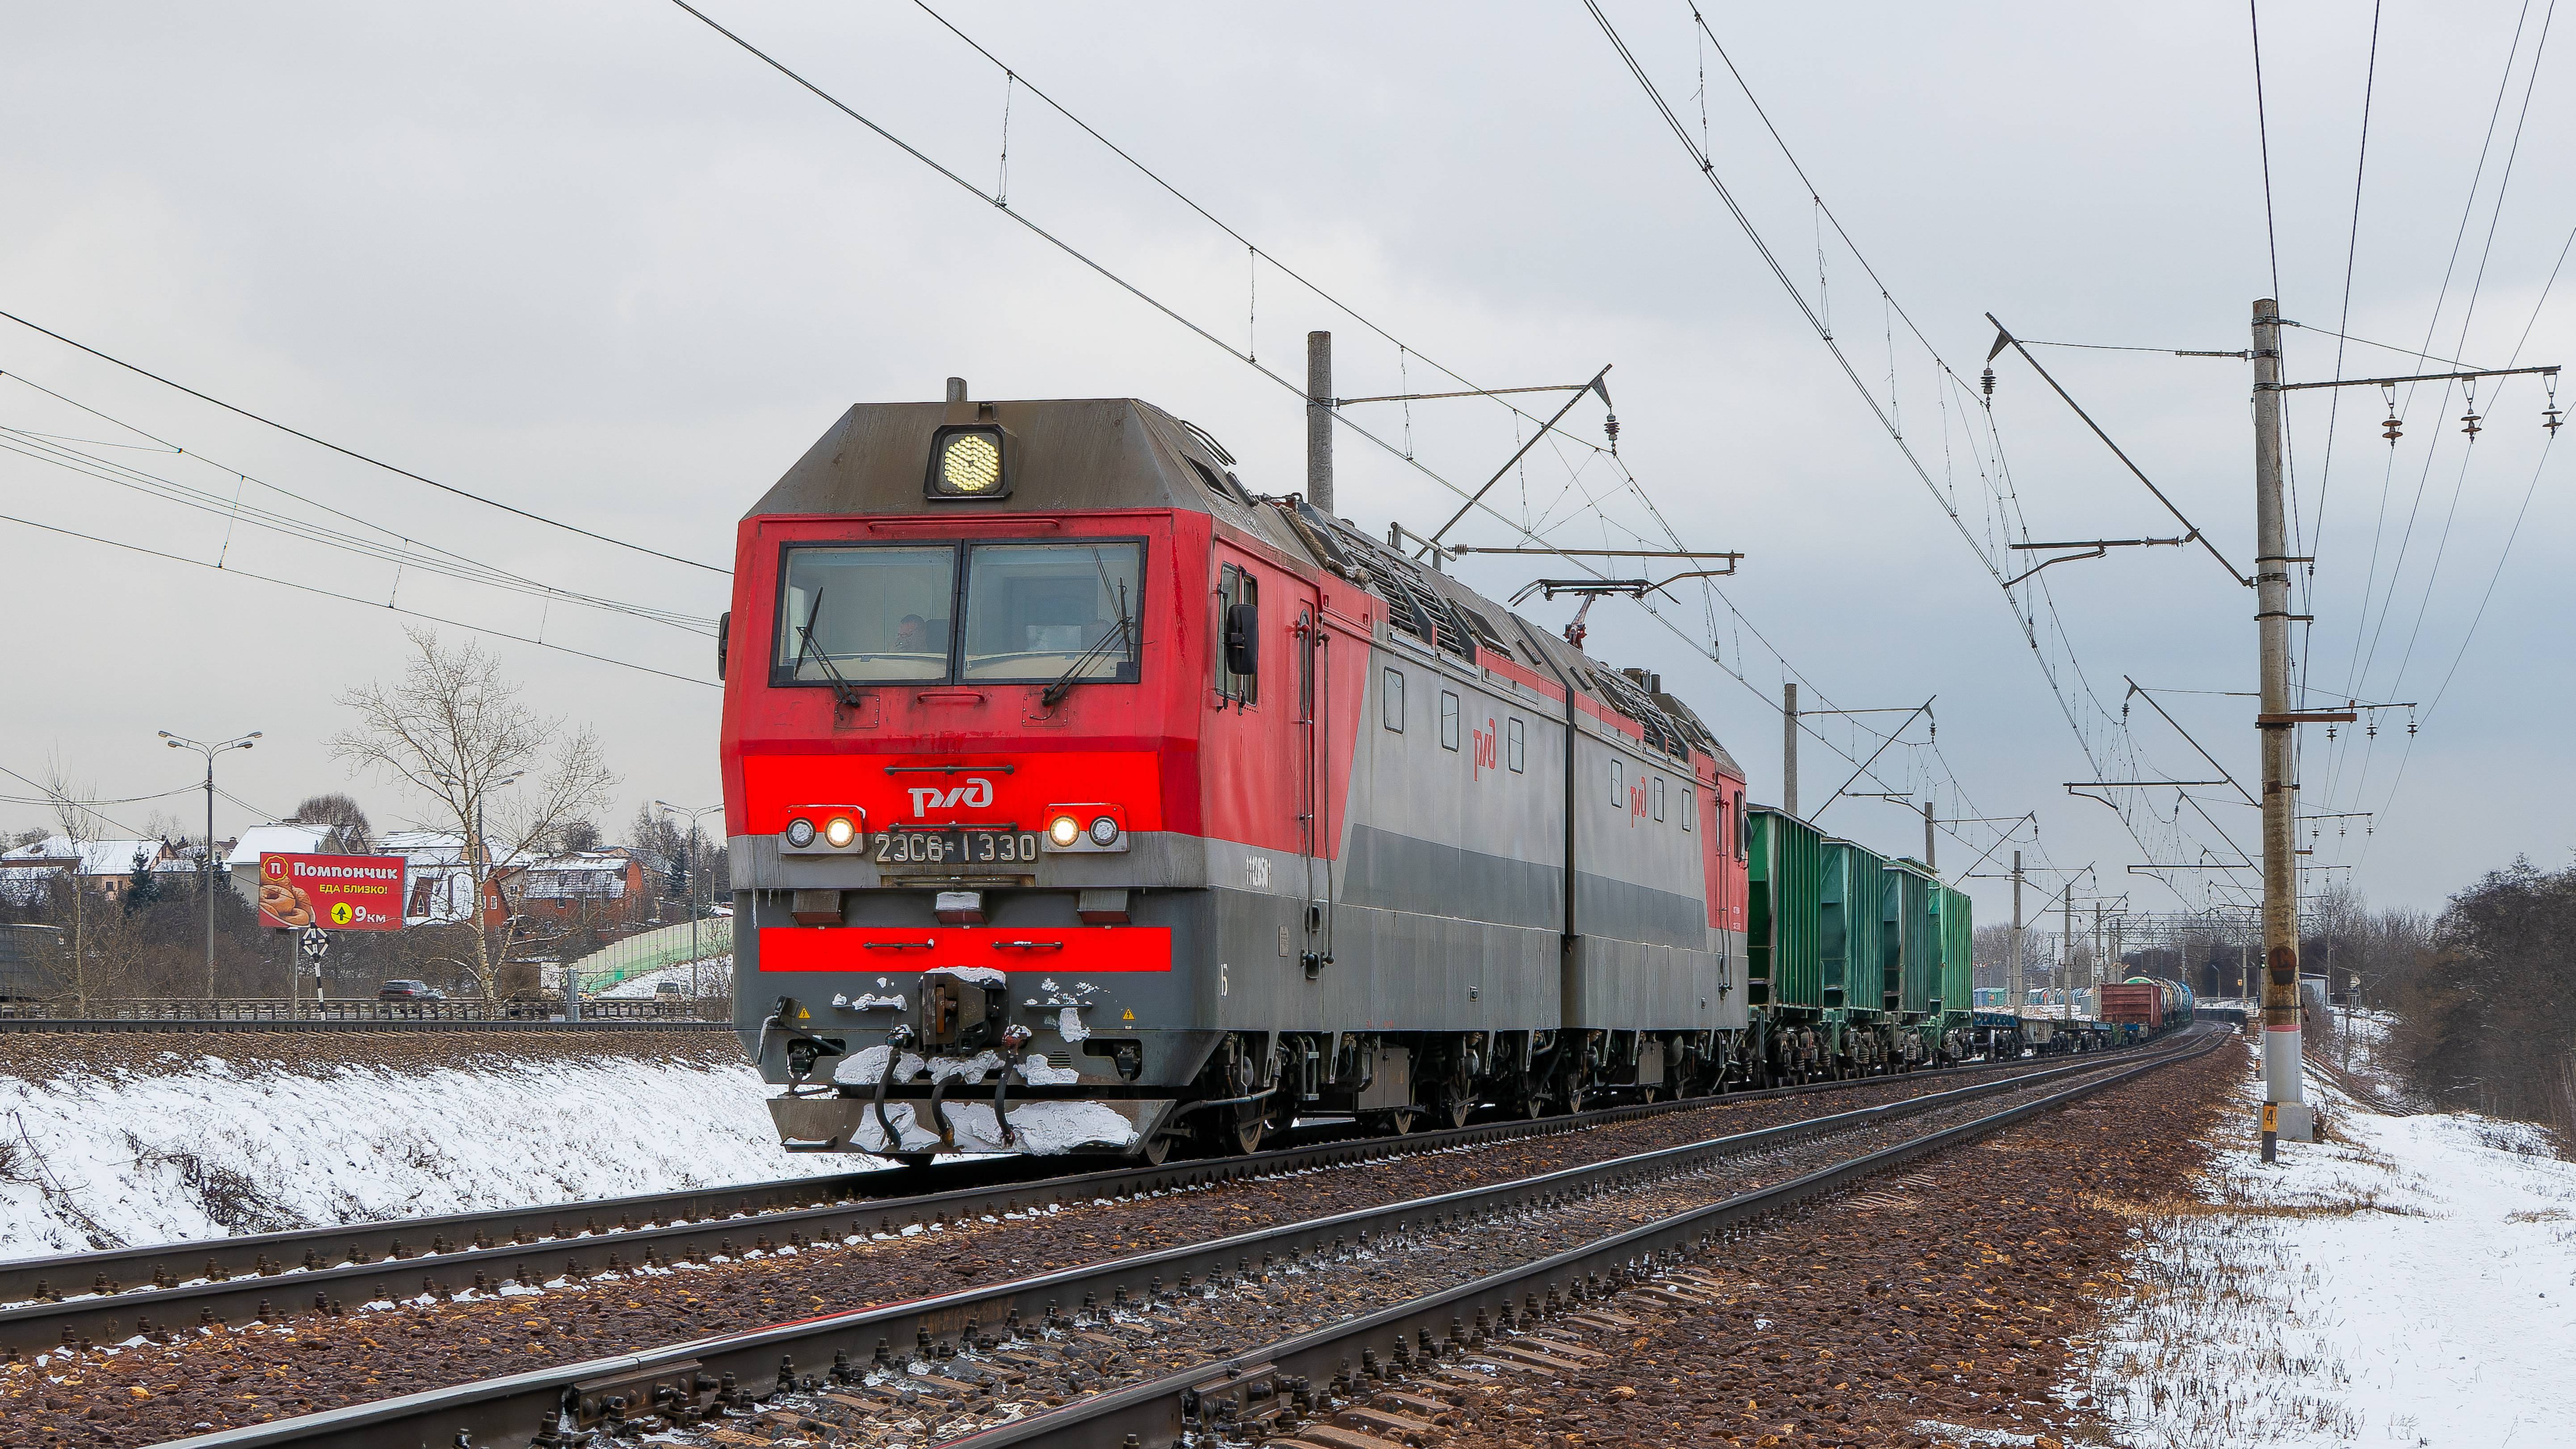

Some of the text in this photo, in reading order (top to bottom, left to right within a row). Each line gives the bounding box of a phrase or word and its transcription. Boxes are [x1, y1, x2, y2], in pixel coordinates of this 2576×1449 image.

[293, 862, 398, 879] Помпончик
[319, 884, 388, 894] ЕДА БЛИЗКО!
[2266, 1109, 2273, 1125] 4
